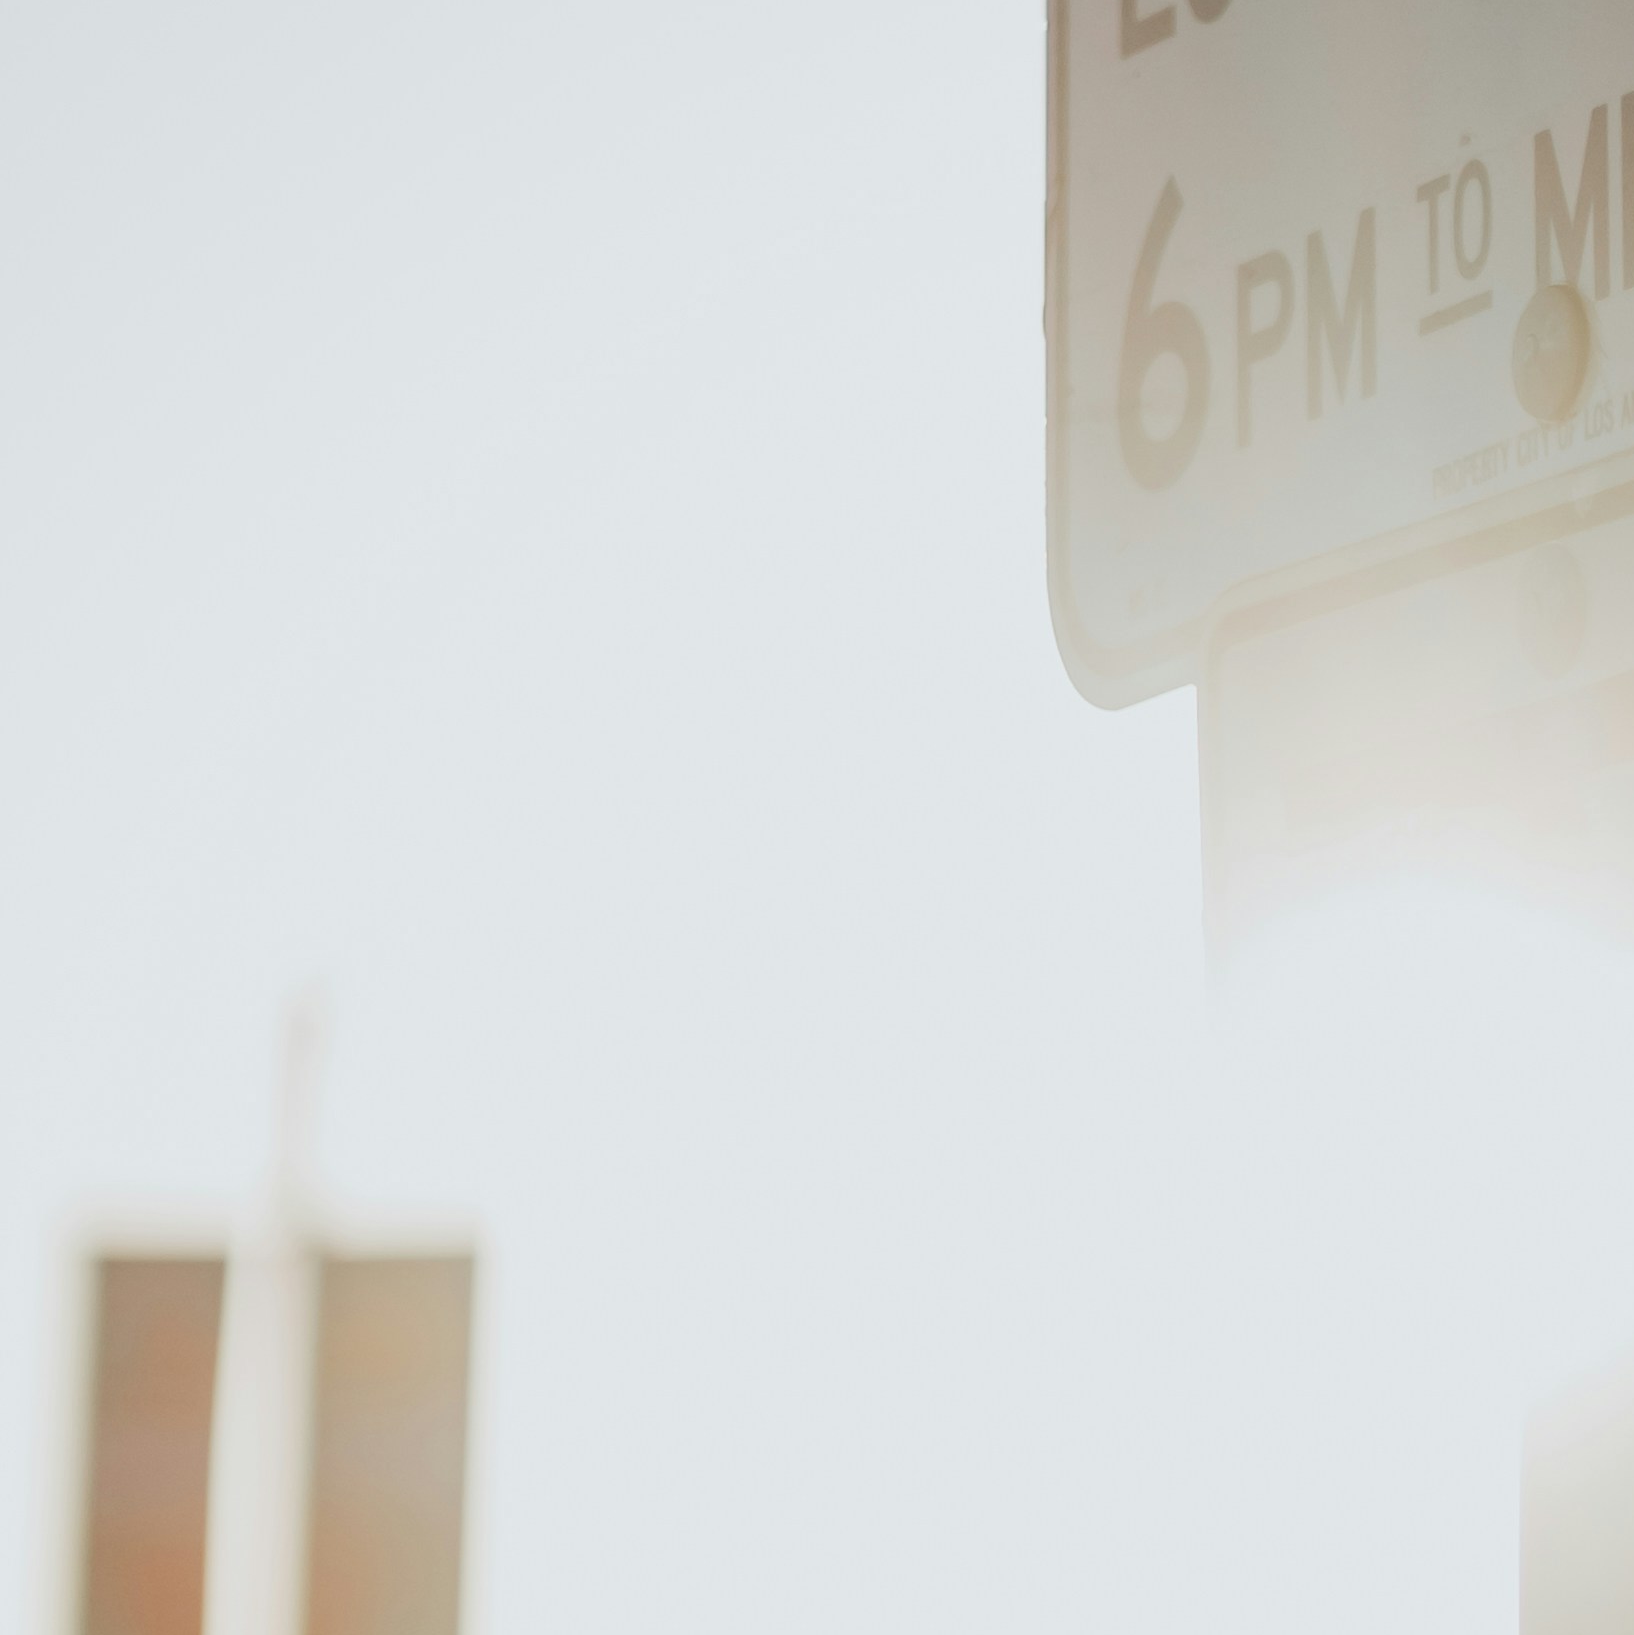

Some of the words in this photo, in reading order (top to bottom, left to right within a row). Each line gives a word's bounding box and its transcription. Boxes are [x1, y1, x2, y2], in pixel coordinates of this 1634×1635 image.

[1416, 158, 1492, 296] TO
[1432, 439, 1510, 500] PROPERTY
[1583, 399, 1615, 442] LOS
